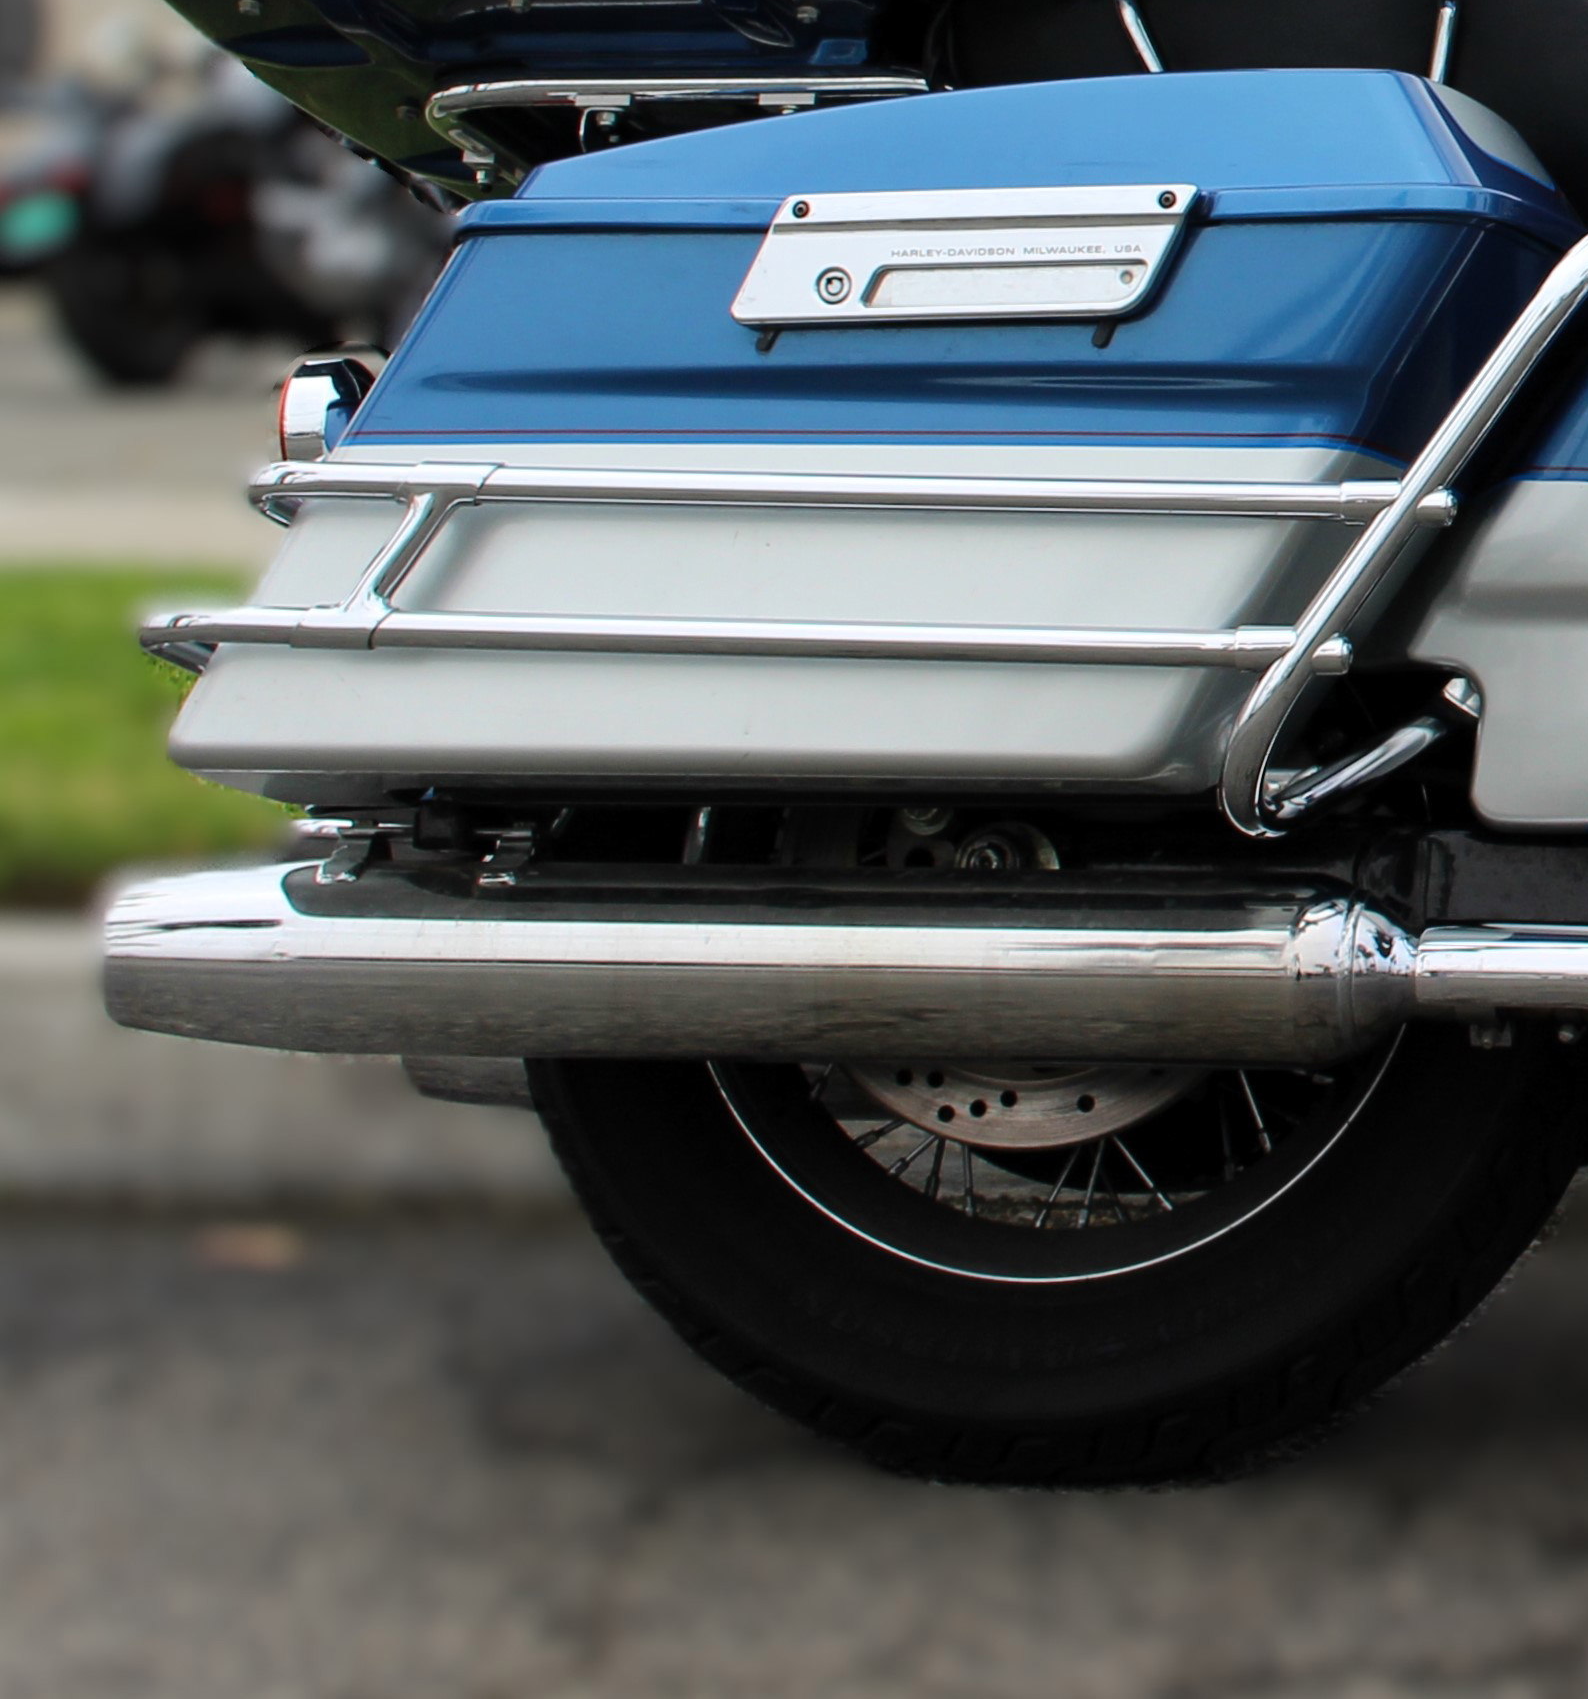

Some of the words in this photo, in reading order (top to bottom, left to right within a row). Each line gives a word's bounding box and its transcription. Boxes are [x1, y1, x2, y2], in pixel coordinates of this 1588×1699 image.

[890, 247, 1016, 258] HARLEY-DAVIDSON
[1022, 245, 1106, 256] MILWAUKEE,
[1114, 244, 1142, 254] USA
